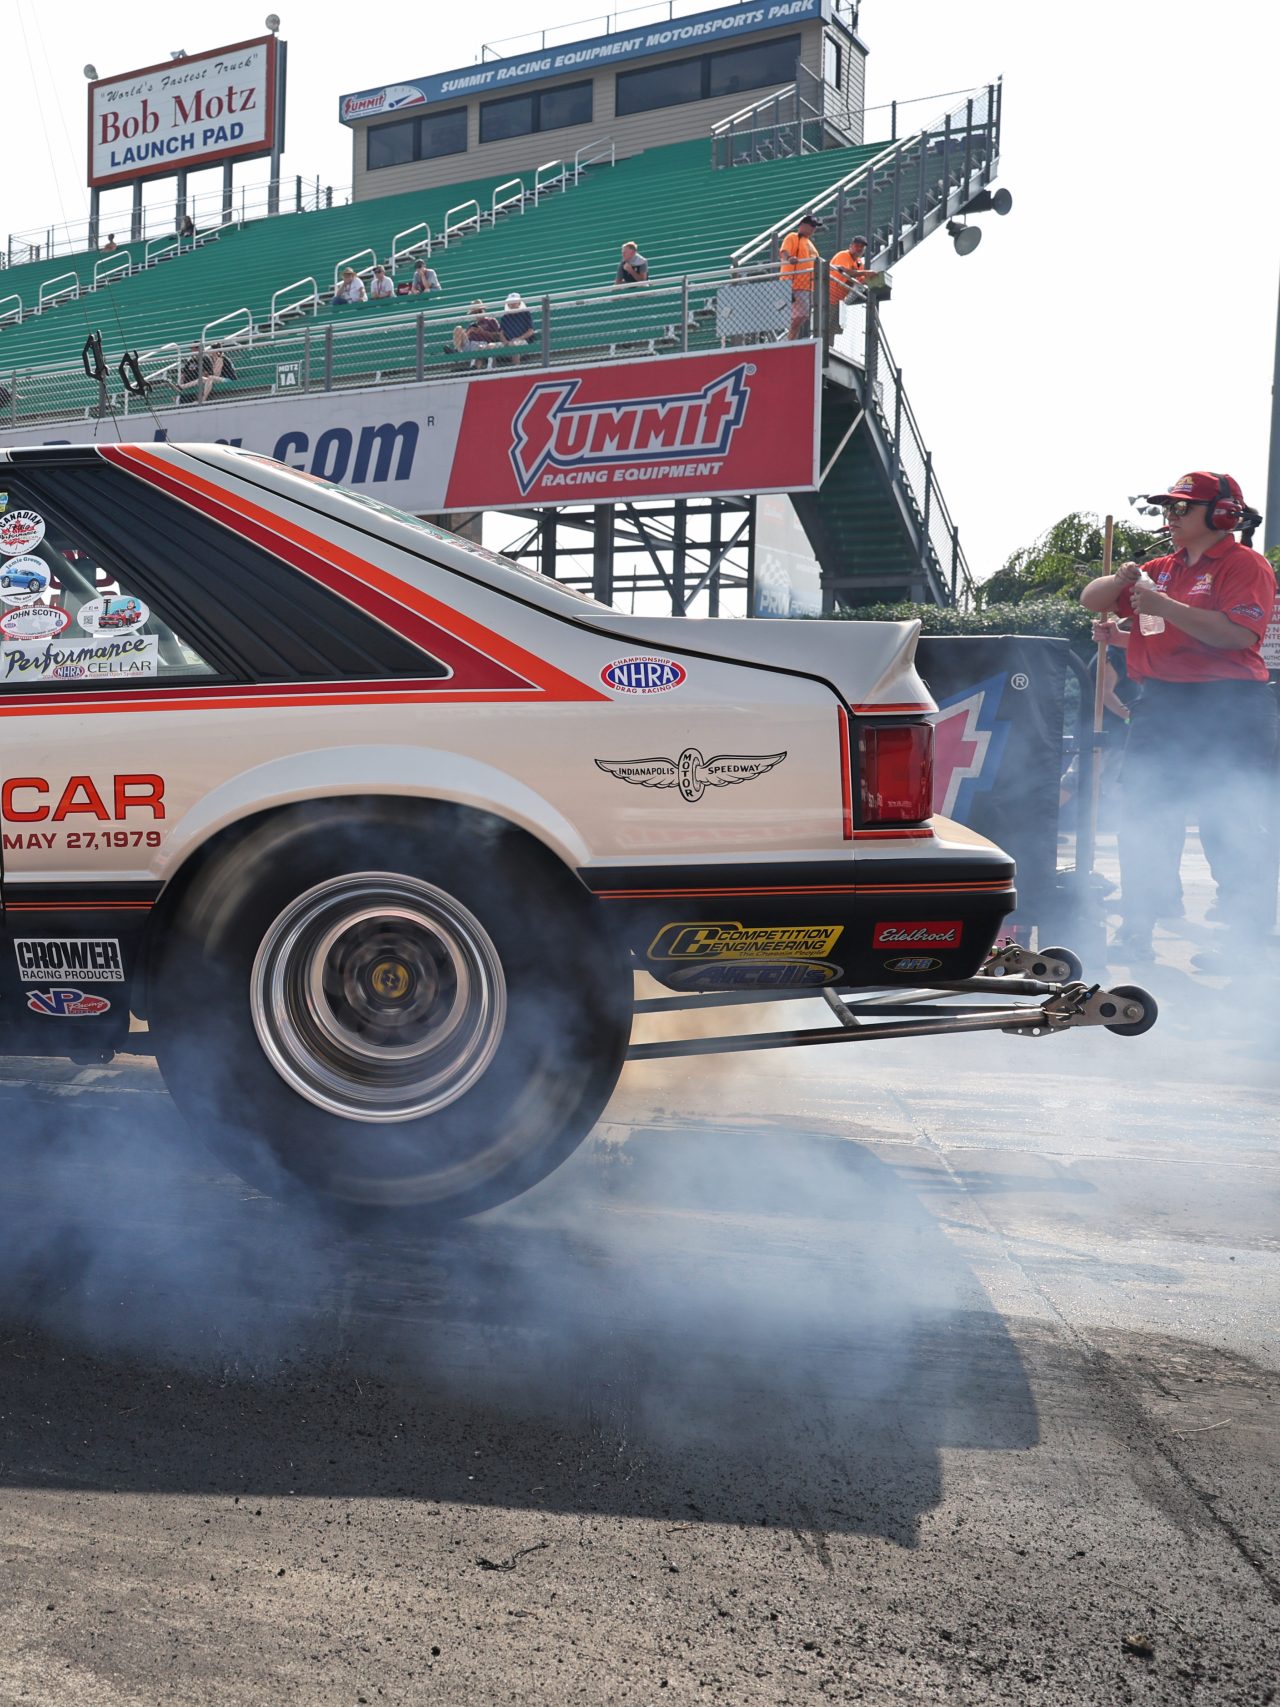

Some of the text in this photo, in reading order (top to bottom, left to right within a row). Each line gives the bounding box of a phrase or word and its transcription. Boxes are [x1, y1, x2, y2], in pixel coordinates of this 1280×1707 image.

[440, 0, 815, 93] SUMMIT RACING EQUIPMENT MOTORSPORTS PARK
[161, 69, 208, 90] Fastest
[98, 86, 256, 145] Bob Motz
[111, 122, 244, 168] LAUNCH PAD
[280, 373, 296, 386] 1A
[541, 462, 723, 487] RACING EQUIPMENT
[8, 609, 61, 622] JOHN SCOTTI
[4, 638, 152, 679] Performance
[87, 661, 151, 673] CELLAR
[613, 656, 671, 668] CHAMPIONSHIP
[57, 666, 81, 678] NHRA
[614, 664, 674, 687] NHRA
[615, 684, 672, 694] DRAG RACING
[619, 763, 762, 776] INDIANAPOLIS SPEEDWAY
[682, 753, 694, 797] MOTOR
[1, 774, 165, 823] CAR
[3, 832, 57, 850] MAY
[719, 929, 834, 941] COMPETITION
[879, 928, 955, 942] Edelbrock
[711, 940, 827, 951] ENGINEERING
[17, 941, 121, 969] CROWER
[22, 970, 122, 980] RACING PRODUCTS
[27, 988, 84, 1015] VP
